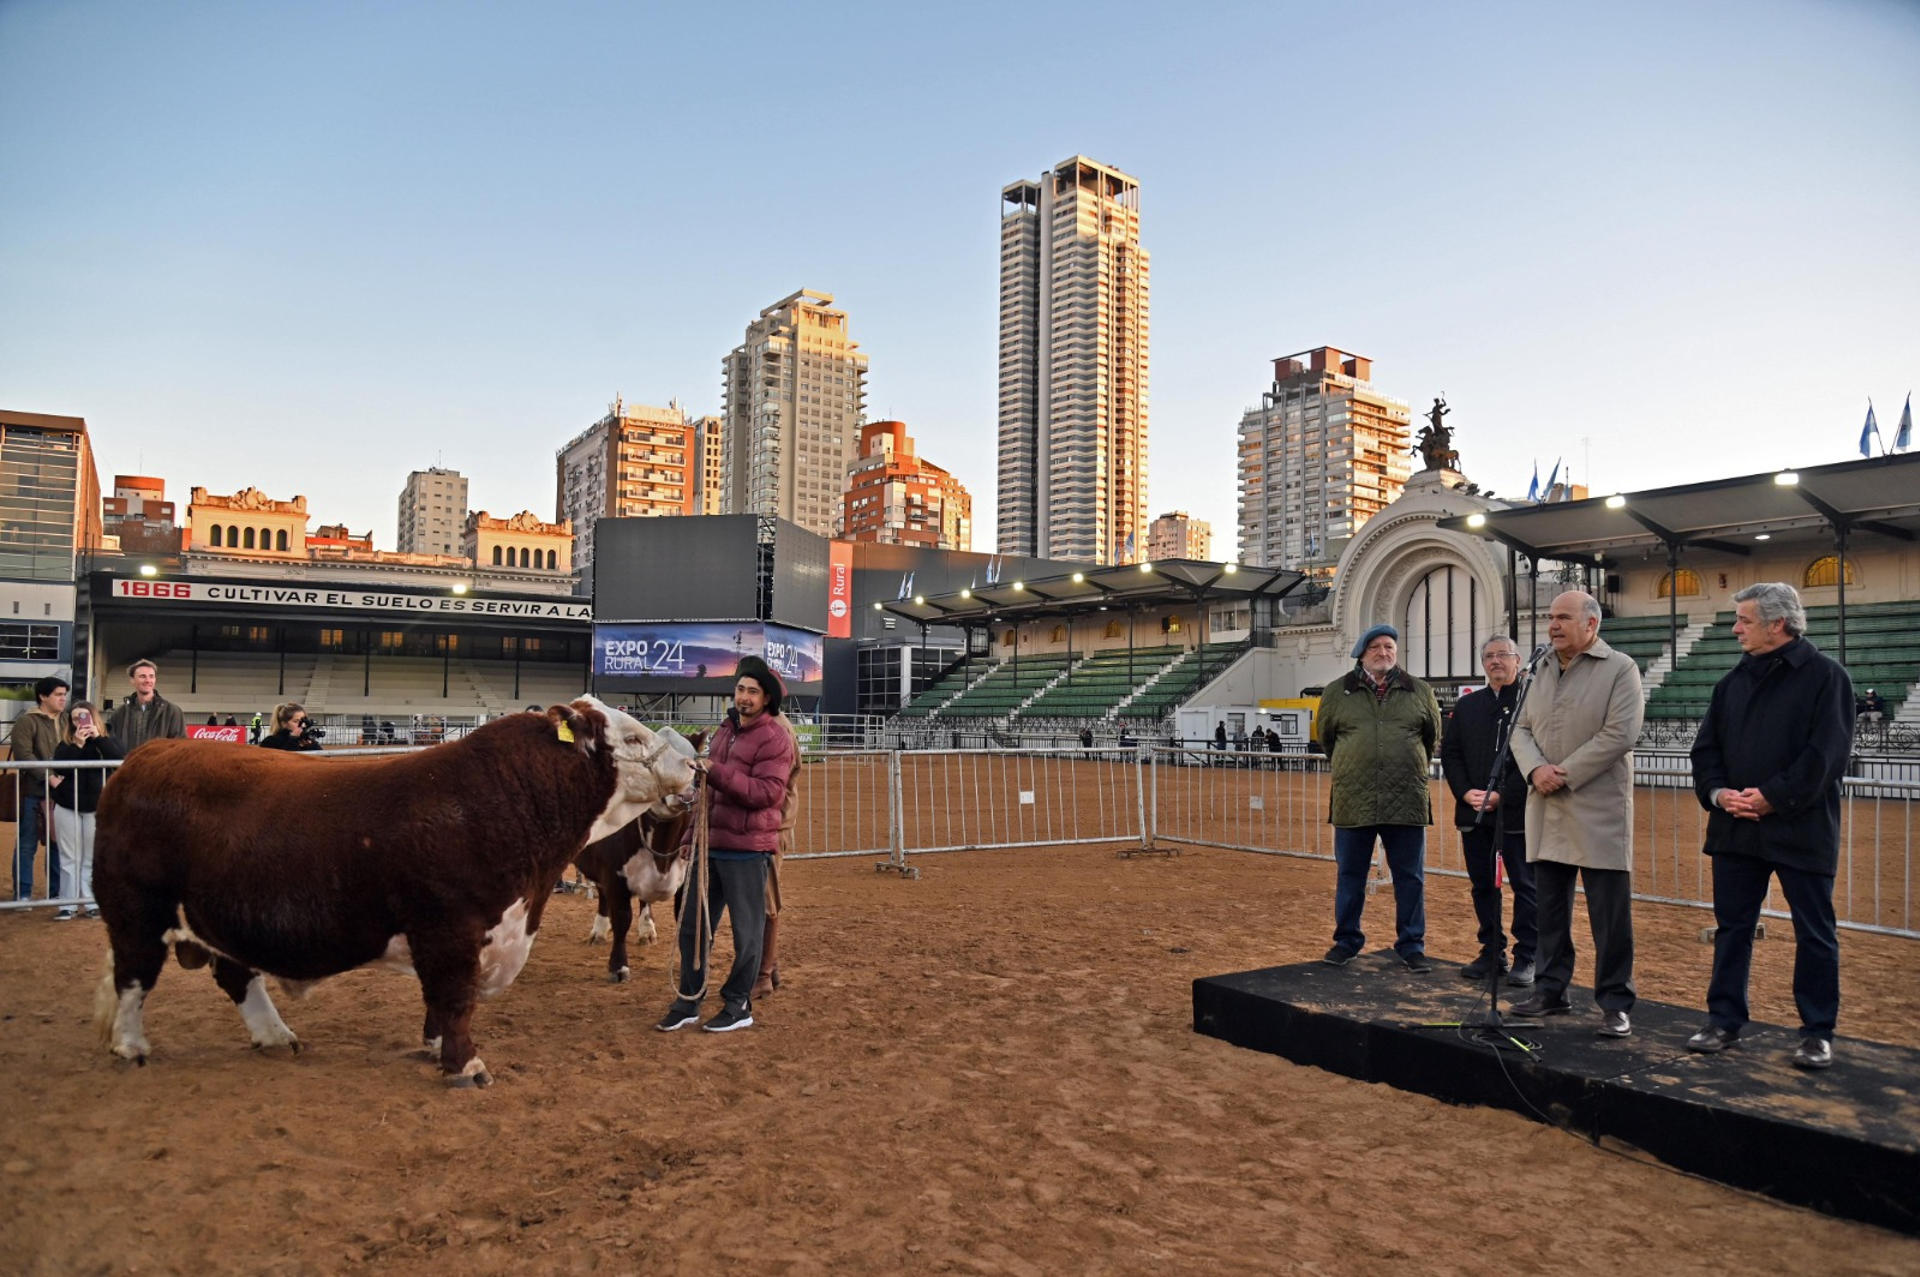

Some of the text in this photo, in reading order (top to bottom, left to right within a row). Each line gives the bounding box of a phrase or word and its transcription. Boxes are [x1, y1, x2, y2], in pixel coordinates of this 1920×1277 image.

[121, 581, 191, 598] 1866
[833, 563, 845, 595] Rural
[207, 587, 591, 617] CULTIVAR EL SUELO ES SERVIR A LA
[605, 640, 648, 656] EXPO
[653, 640, 685, 670] 24
[767, 641, 785, 658] EXPO
[785, 644, 798, 674] 24
[605, 656, 652, 670] RURAL
